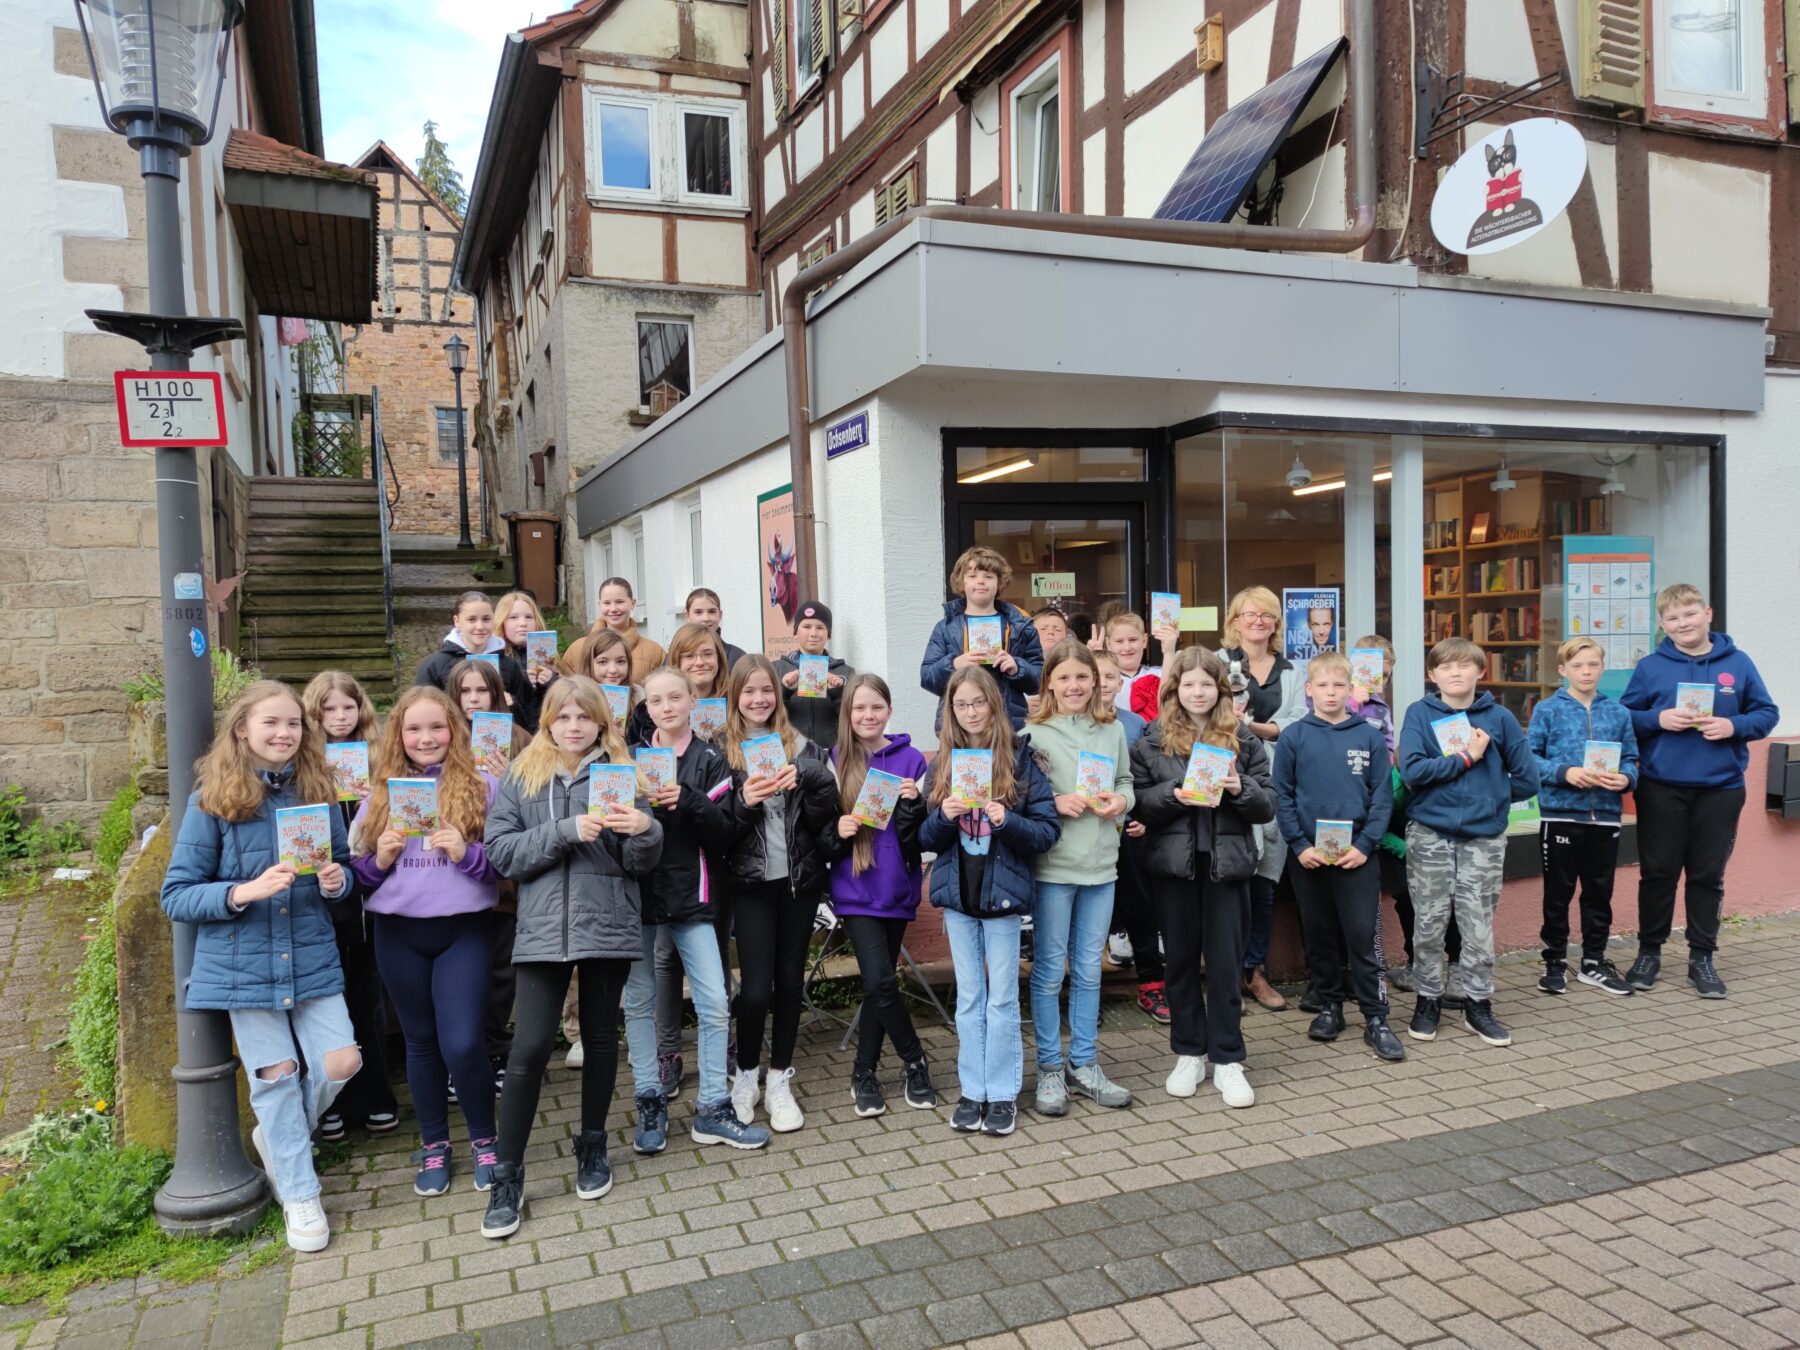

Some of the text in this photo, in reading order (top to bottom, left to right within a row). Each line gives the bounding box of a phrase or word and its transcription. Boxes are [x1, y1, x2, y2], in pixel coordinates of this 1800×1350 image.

[1471, 215, 1538, 243] ALTSTADTBUCHHANDLUNG
[1474, 226, 1483, 235] DIE
[135, 381, 194, 397] H100
[828, 422, 863, 451] Ochsenberg
[1044, 581, 1072, 590] Offen
[1287, 599, 1335, 609] SCHROEDER
[1347, 749, 1370, 758] CHICAGO
[1555, 835, 1571, 844] T.H.
[403, 857, 448, 868] BROOKLYN
